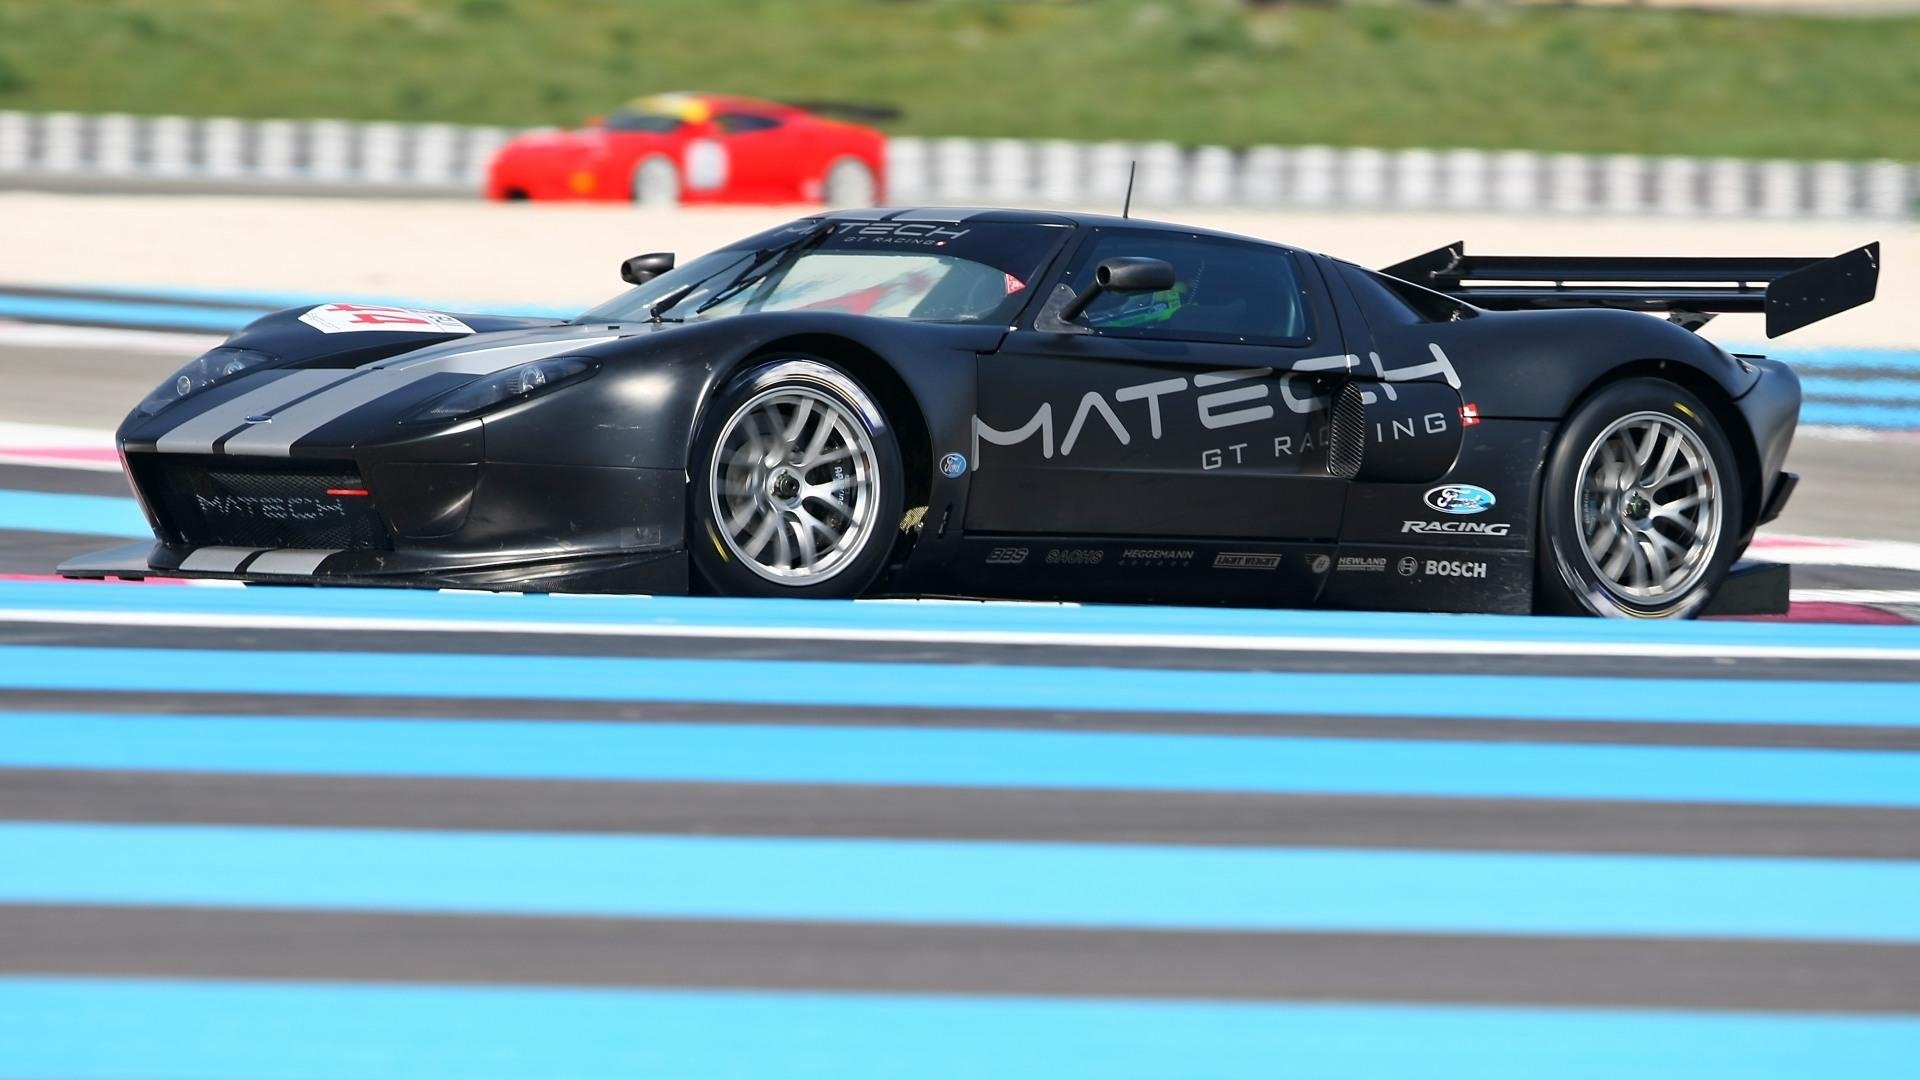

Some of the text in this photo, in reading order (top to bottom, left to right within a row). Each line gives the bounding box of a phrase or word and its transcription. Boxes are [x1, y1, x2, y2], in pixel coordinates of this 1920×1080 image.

[773, 222, 971, 240] MTECH
[874, 237, 936, 246] RACING
[972, 342, 1462, 472] MATECH
[1202, 443, 1248, 470] GT
[196, 494, 345, 520] MATECH
[1401, 520, 1511, 536] RACING
[986, 547, 1030, 563] BBS
[1045, 549, 1103, 564] SACHS
[1122, 549, 1194, 560] HEGGEMANN
[1338, 557, 1387, 565] HEWLAND
[1425, 560, 1487, 578] BOSCH
